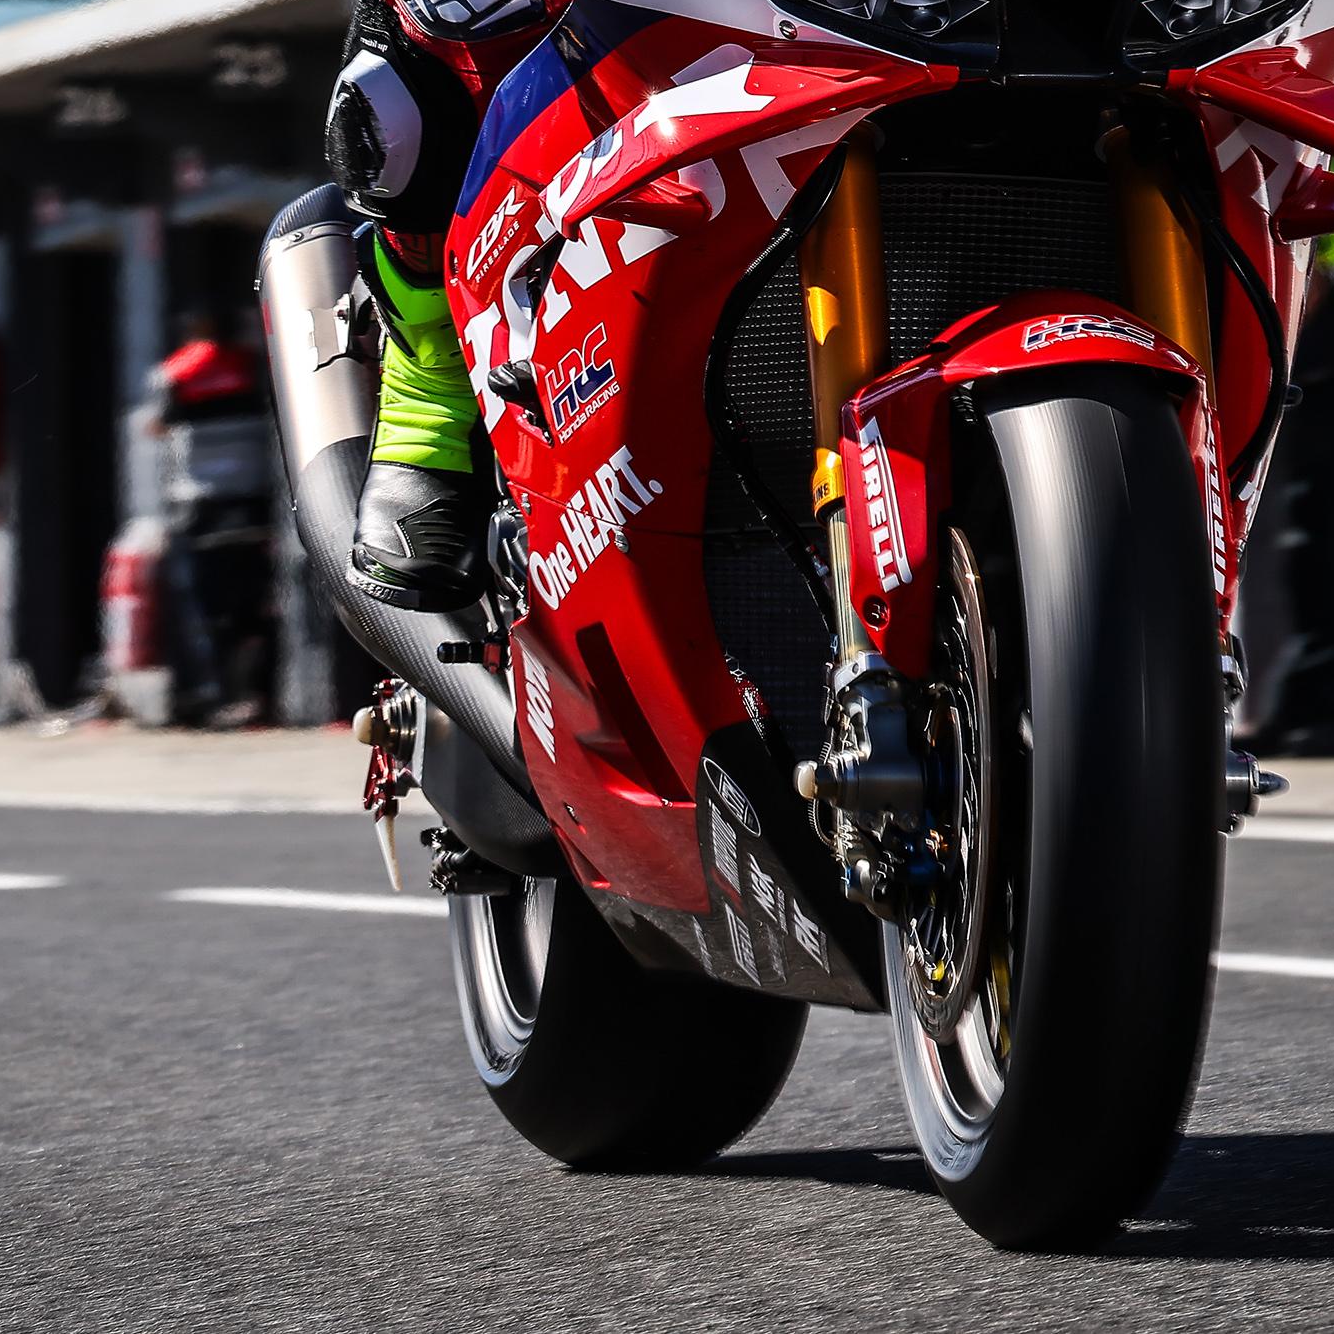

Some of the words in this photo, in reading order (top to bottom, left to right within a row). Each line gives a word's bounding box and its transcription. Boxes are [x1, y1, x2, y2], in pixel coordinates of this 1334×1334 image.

[466, 185, 526, 281] CBR
[475, 219, 521, 284] FIREBLADE
[1021, 314, 1156, 351] HRC
[544, 321, 616, 431] HRC
[558, 410, 589, 444] Honda
[585, 380, 621, 419] RACING
[528, 539, 578, 611] One
[560, 444, 664, 573] HEART.
[859, 416, 913, 593] PIRELLI
[748, 852, 779, 923] NGK
